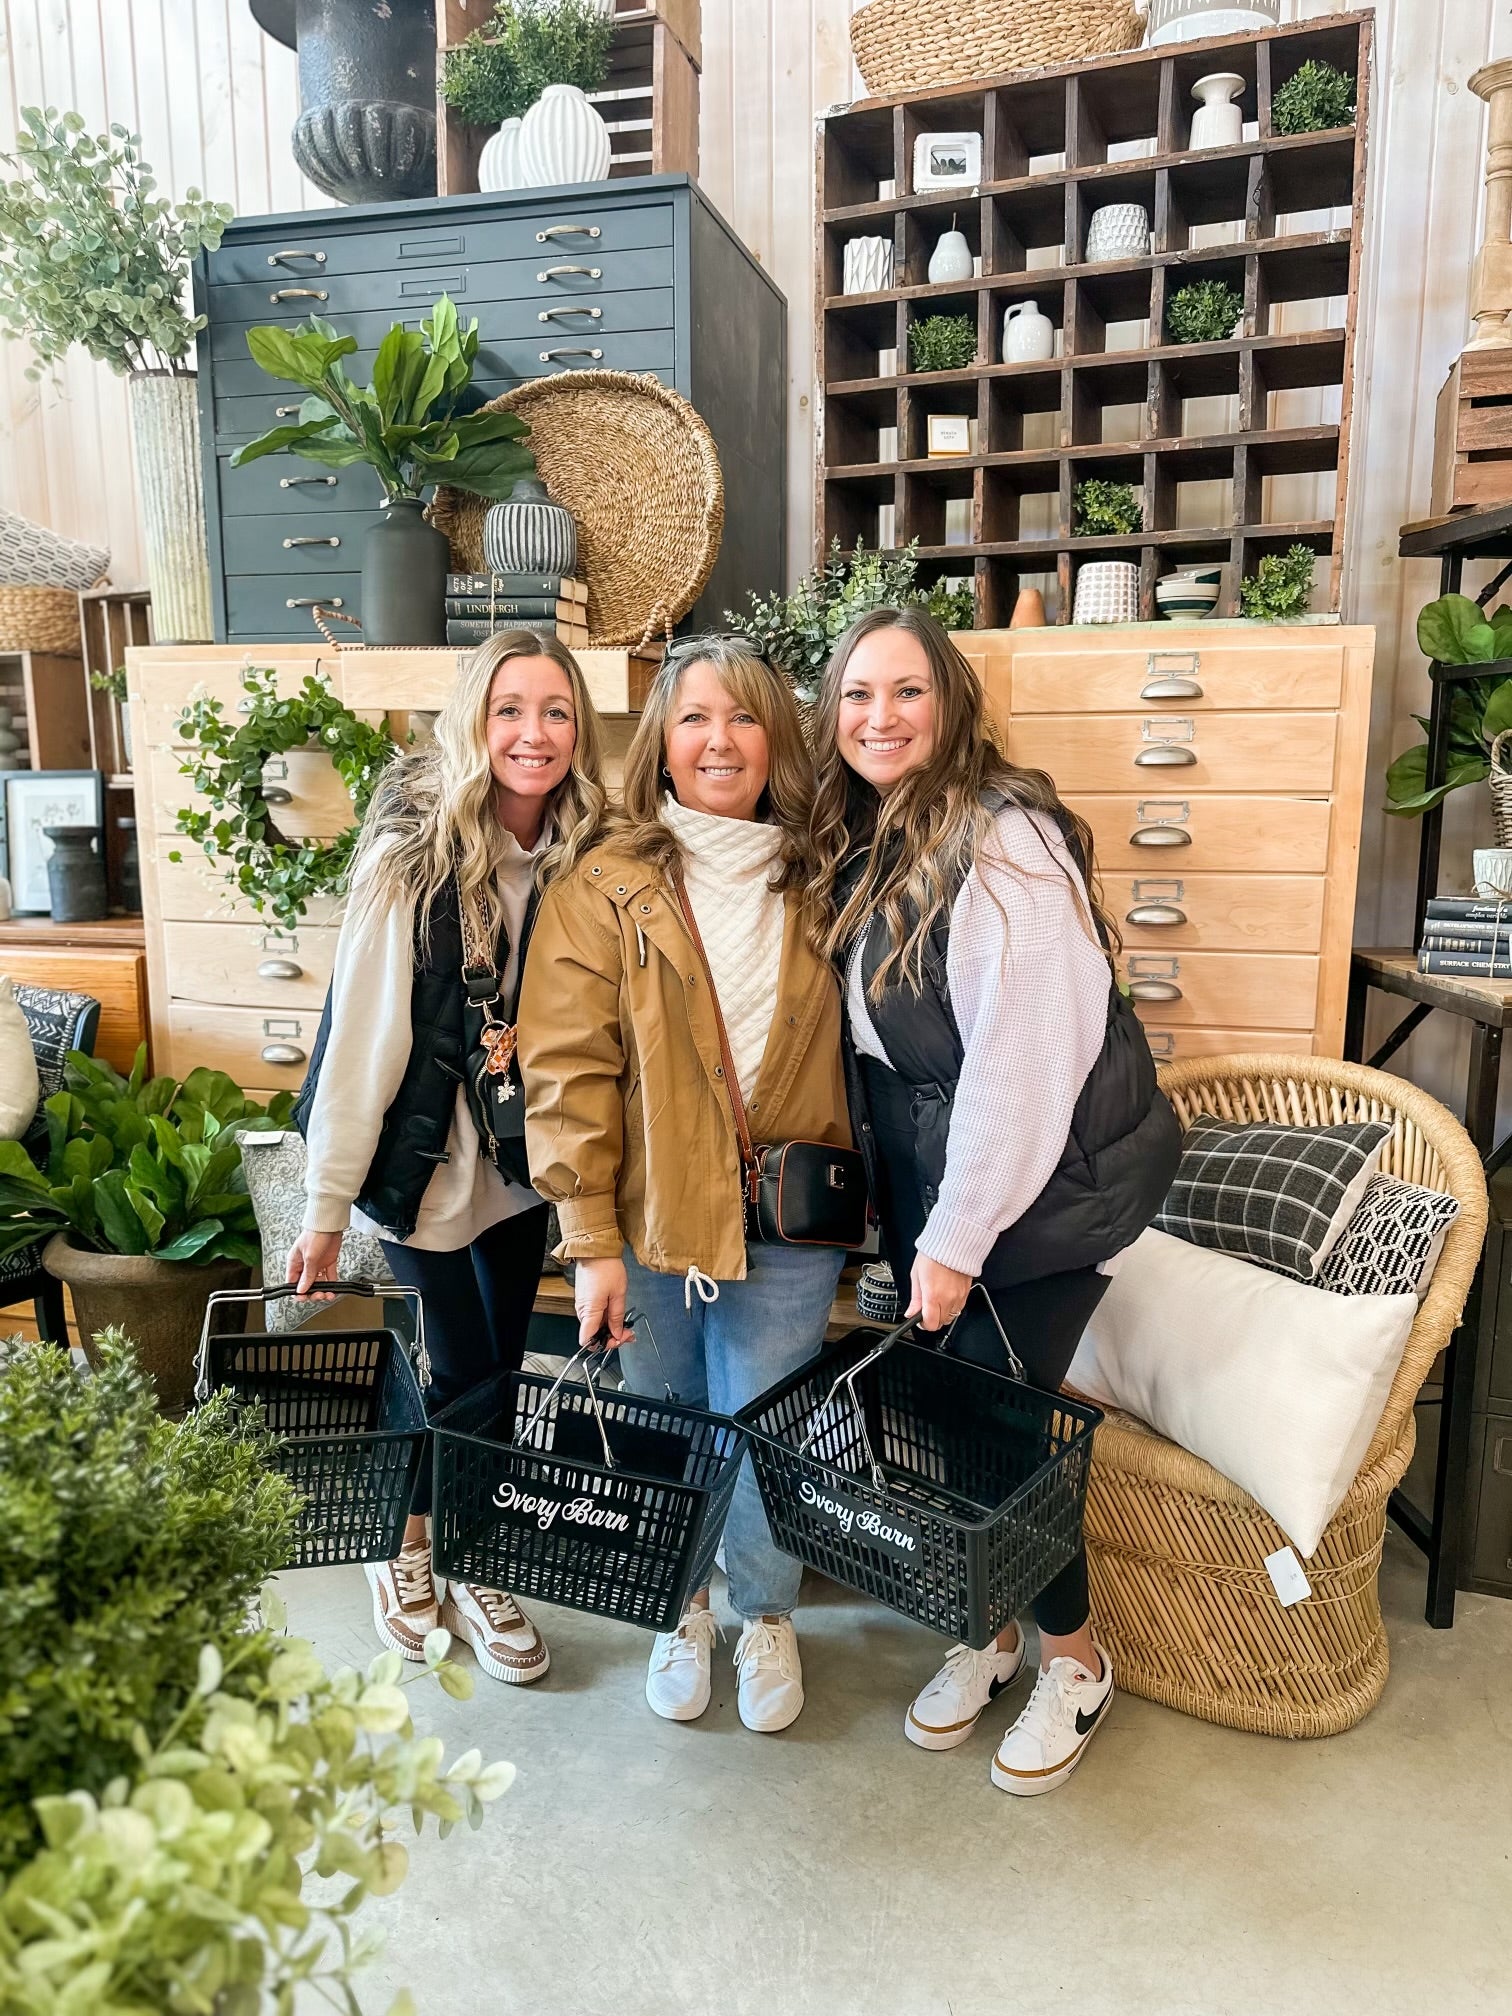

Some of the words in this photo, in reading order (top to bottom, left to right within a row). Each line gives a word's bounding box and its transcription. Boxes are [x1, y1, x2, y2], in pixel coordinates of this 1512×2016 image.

[460, 581, 467, 590] OF
[1471, 961, 1511, 970] CHEMSTRY
[492, 1482, 561, 1530] Ivory
[561, 1497, 629, 1532] Barn
[798, 1481, 854, 1533] Ivory
[855, 1510, 916, 1551] Barn
